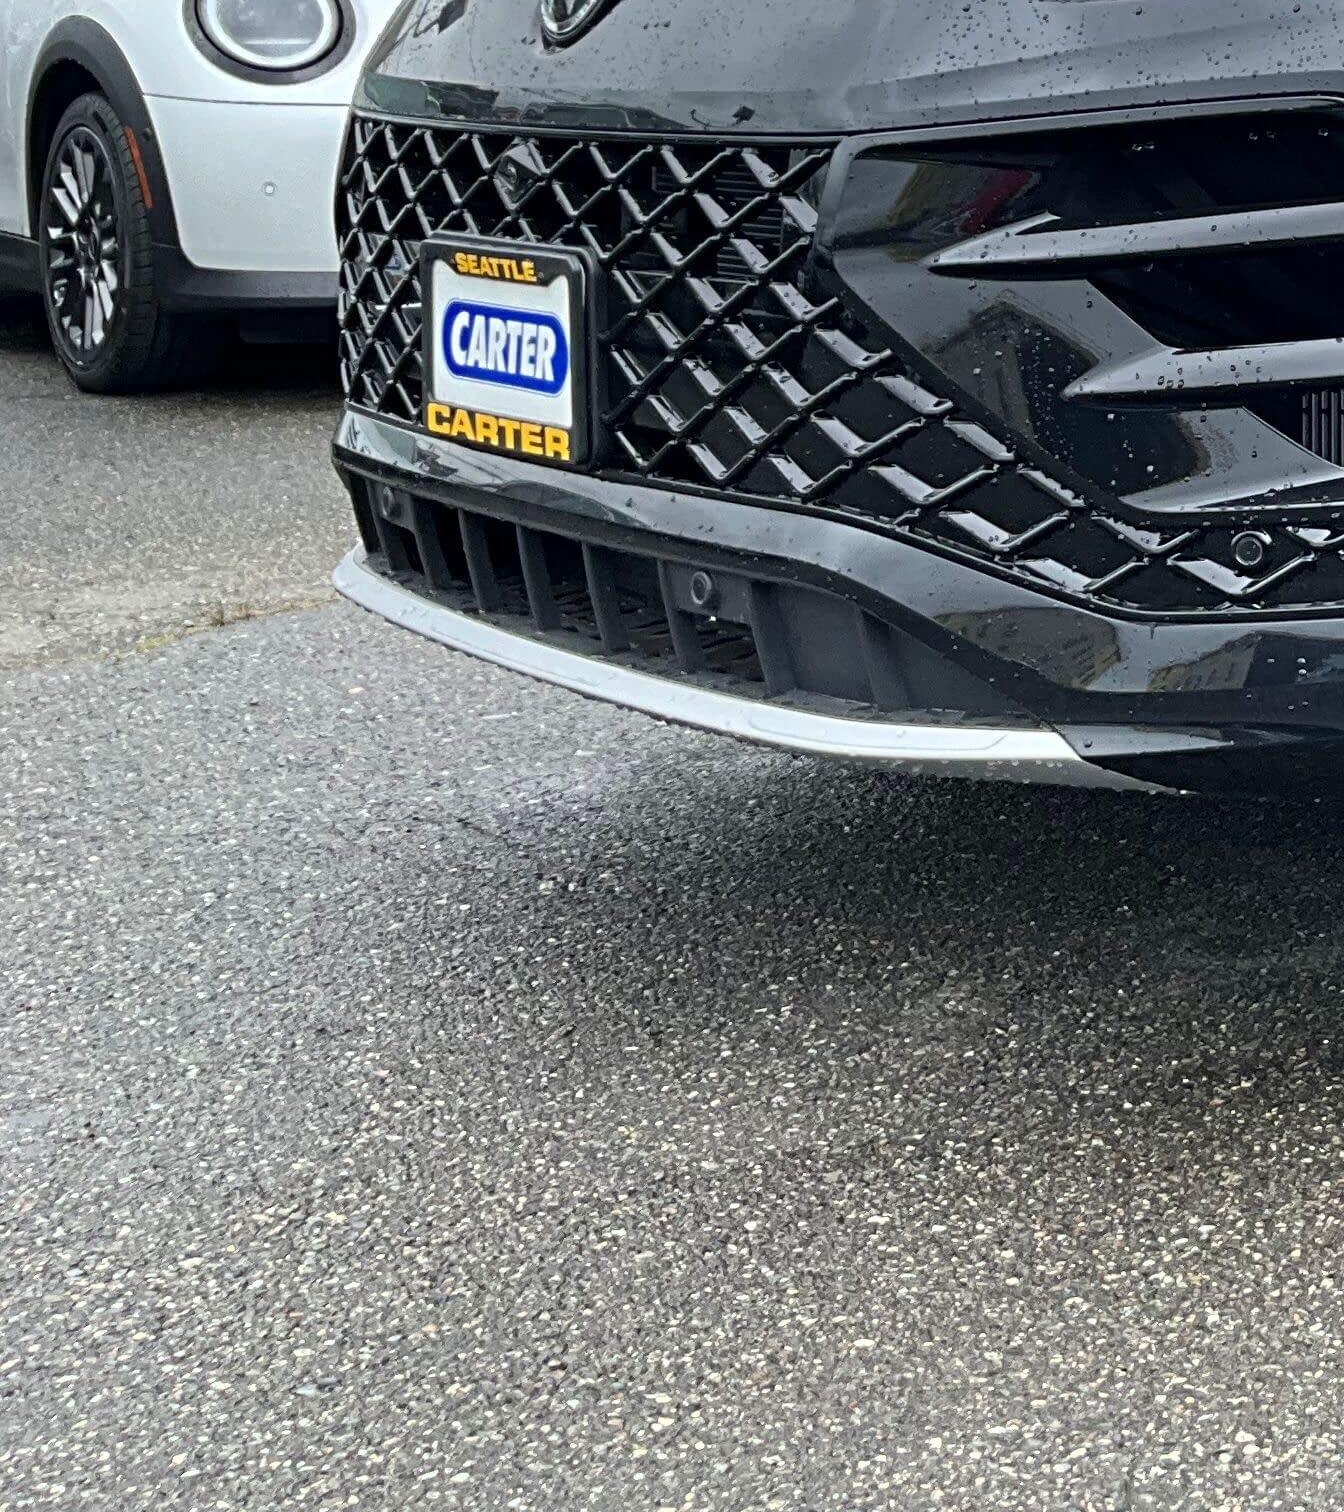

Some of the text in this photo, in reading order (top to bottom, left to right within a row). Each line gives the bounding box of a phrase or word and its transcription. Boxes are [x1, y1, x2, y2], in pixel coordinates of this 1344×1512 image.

[454, 252, 537, 282] SEATTLE
[451, 311, 557, 381] CARTER
[427, 402, 570, 461] CARTER
